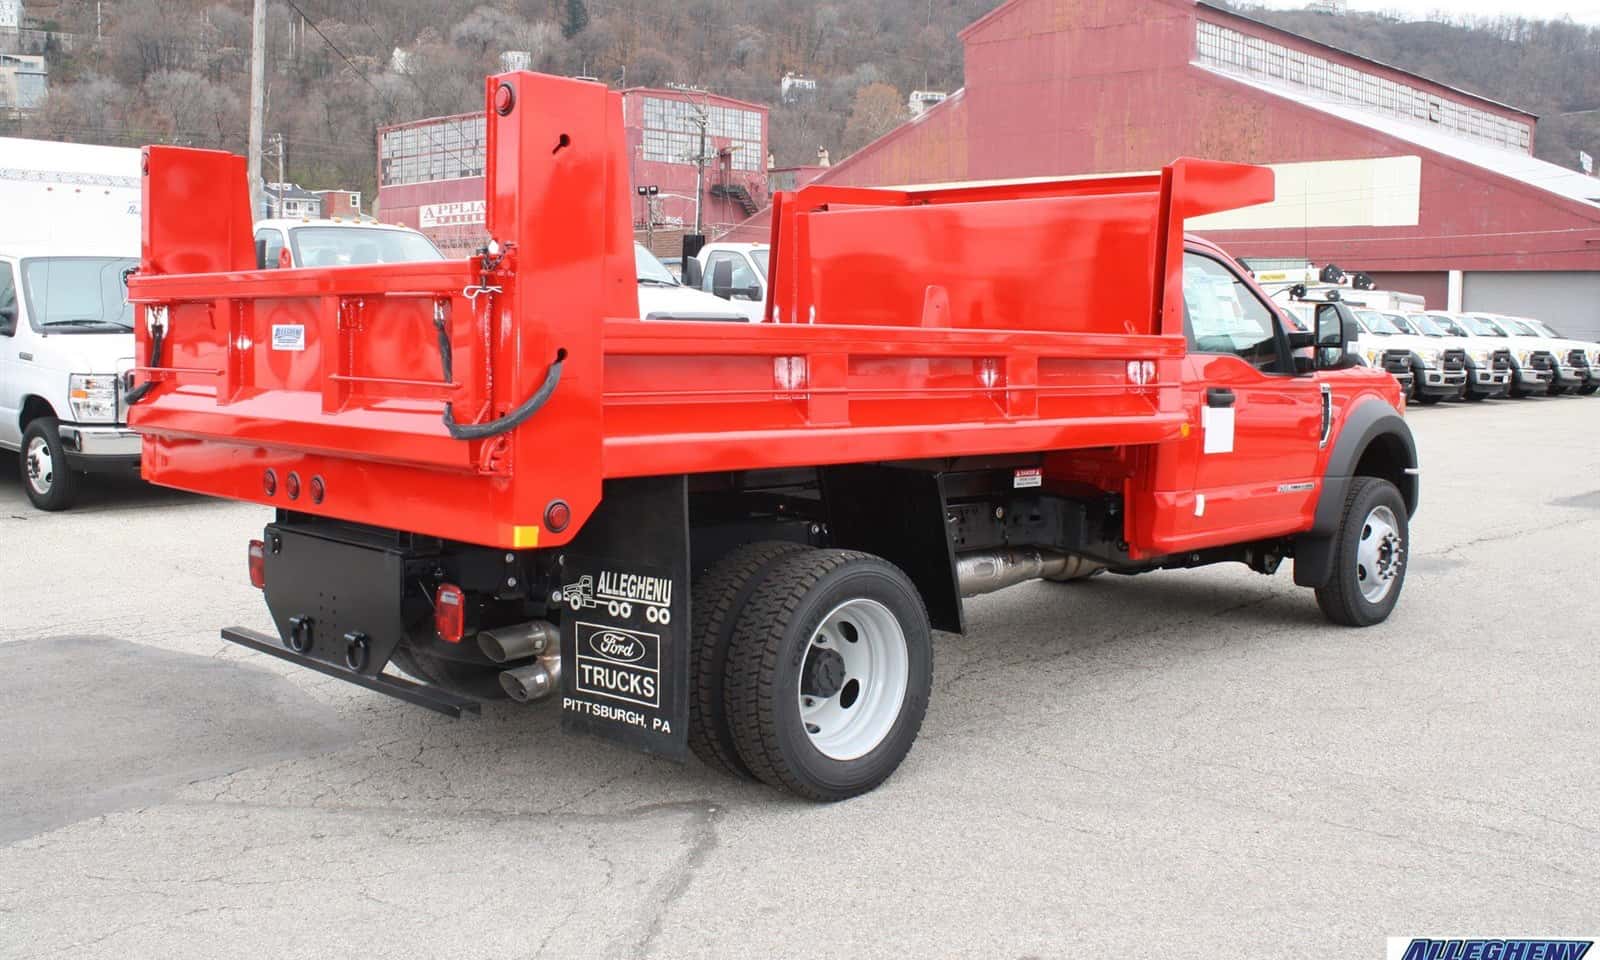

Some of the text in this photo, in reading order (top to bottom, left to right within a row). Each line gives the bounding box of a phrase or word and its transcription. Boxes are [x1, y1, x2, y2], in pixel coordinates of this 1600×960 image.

[597, 571, 672, 605] ALLEGHENY
[600, 632, 635, 657] Ford
[580, 664, 655, 698] TRUCKS
[563, 697, 671, 734] PITTSBURGH, PA
